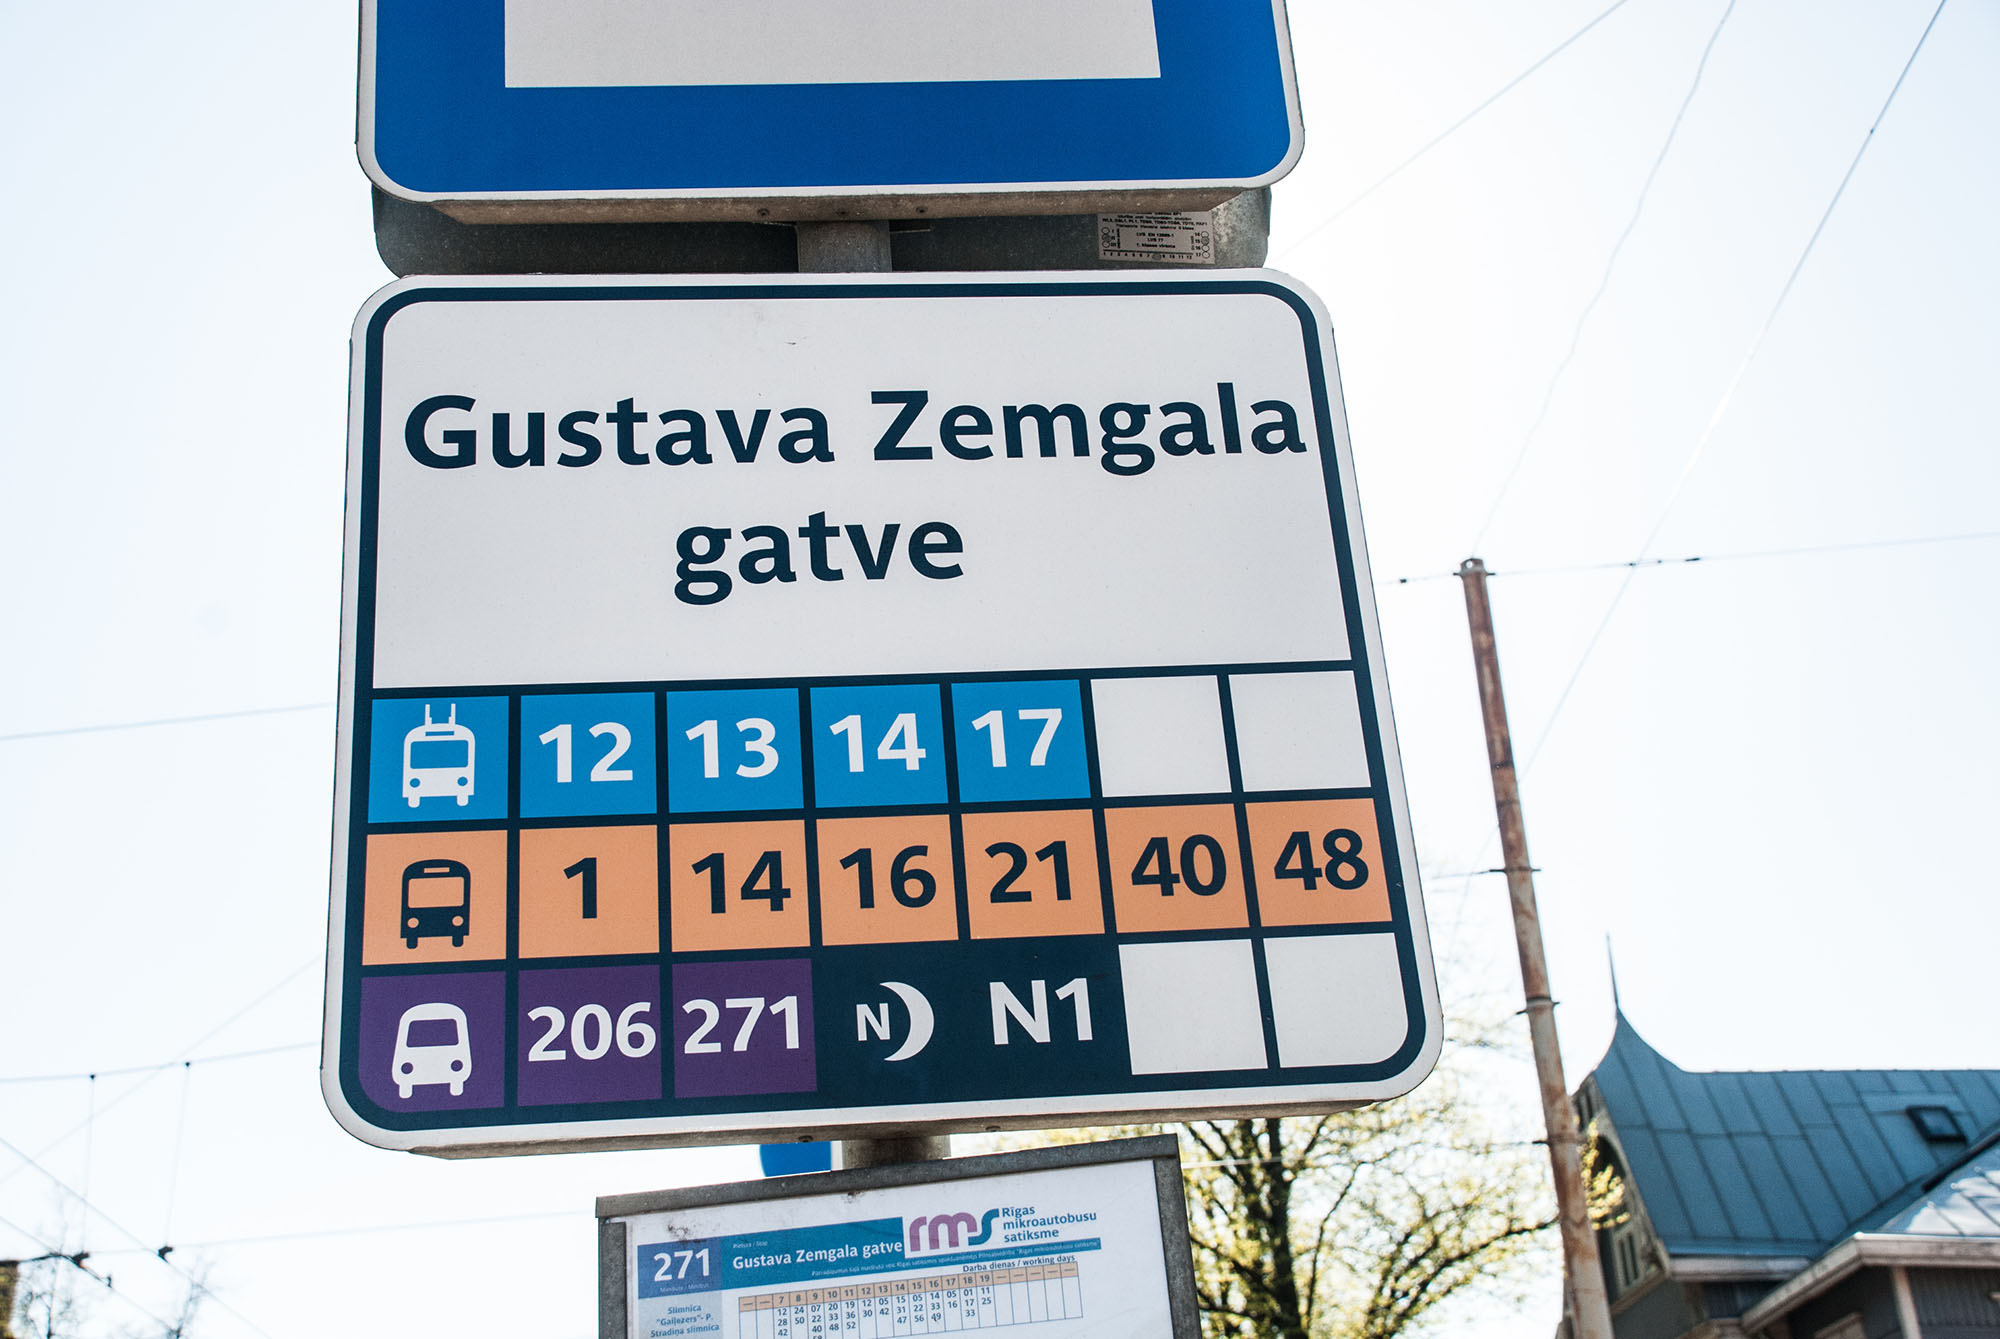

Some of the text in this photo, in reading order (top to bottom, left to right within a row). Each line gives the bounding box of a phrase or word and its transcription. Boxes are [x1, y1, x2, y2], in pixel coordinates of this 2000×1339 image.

[404, 382, 1308, 477] Gustava Zemgala
[674, 510, 964, 606] gatve
[538, 707, 1063, 783] 12 13 14 17
[563, 827, 1370, 920] 1 14 16 21 40 48
[527, 977, 1093, 1062] 206 271 N N1
[1001, 1206, 1036, 1218] Rīgas
[1003, 1212, 1097, 1230] mikroautobusu
[909, 1208, 1000, 1252] rms
[1004, 1229, 1060, 1243] satiksme
[653, 1248, 710, 1282] 271
[733, 1241, 903, 1270] Gustava Zemgala gatve
[963, 1264, 987, 1272] Darba
[990, 1261, 1015, 1270] dienas
[1023, 1255, 1055, 1266] working
[1057, 1254, 1075, 1264] days
[828, 1290, 838, 1298] 10
[845, 1289, 854, 1297] 11
[862, 1287, 871, 1295] 12
[879, 1285, 888, 1293] 13
[896, 1283, 904, 1291] 14
[912, 1282, 922, 1290] 15
[929, 1280, 938, 1288] 16
[946, 1278, 955, 1286] 17
[963, 1276, 972, 1284] 18
[980, 1274, 990, 1282] 19
[778, 1308, 787, 1316] 12
[794, 1306, 804, 1314] 24
[811, 1304, 820, 1312] 07
[828, 1303, 838, 1311] 20
[846, 1301, 855, 1309] 19
[862, 1299, 872, 1307] 12
[896, 1295, 906, 1303] 15
[913, 1294, 922, 1302] 05
[930, 1292, 940, 1300] 14
[947, 1290, 956, 1298] 05
[964, 1288, 973, 1296] 01
[981, 1286, 990, 1294] 11
[778, 1318, 788, 1326] 28
[829, 1313, 839, 1321] 33
[846, 1311, 856, 1319] 36
[863, 1309, 873, 1317] 30
[897, 1306, 906, 1314] 31
[914, 1304, 923, 1312] 22
[931, 1302, 940, 1310] 33
[948, 1300, 958, 1308] 16
[982, 1297, 992, 1305] 25
[812, 1325, 822, 1333] 40
[829, 1323, 839, 1331] 48
[846, 1321, 856, 1329] 52
[897, 1316, 907, 1324] 47
[915, 1314, 924, 1322] 56
[966, 1309, 975, 1317] 33
